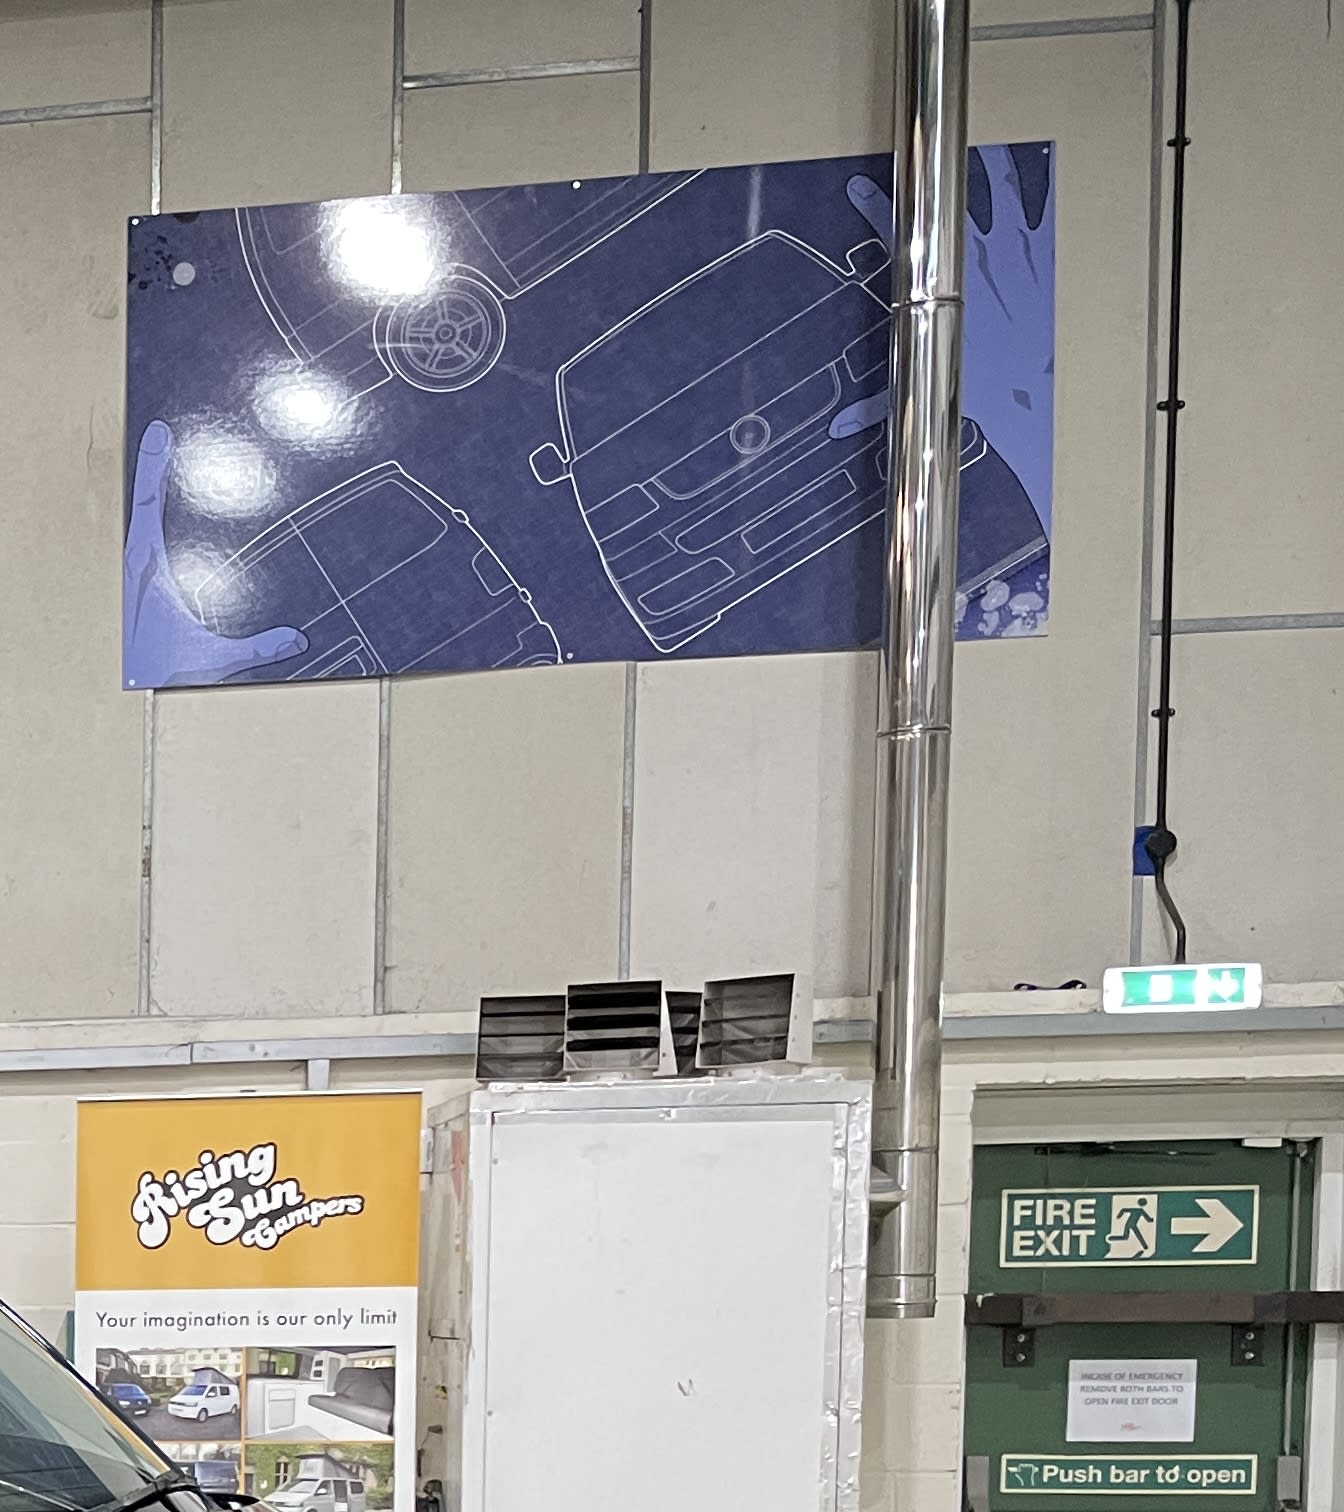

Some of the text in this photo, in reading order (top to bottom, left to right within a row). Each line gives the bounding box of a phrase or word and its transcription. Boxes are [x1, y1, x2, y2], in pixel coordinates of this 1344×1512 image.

[131, 1142, 277, 1249] Rising
[186, 1178, 305, 1245] Sun
[239, 1195, 364, 1250] Campers
[1013, 1198, 1097, 1226] FIRE
[1012, 1229, 1096, 1257] EXIT
[95, 1307, 397, 1332] Your imagination is our only limit
[1171, 1385, 1184, 1393] TO
[1042, 1465, 1246, 1487] Push bar to open
